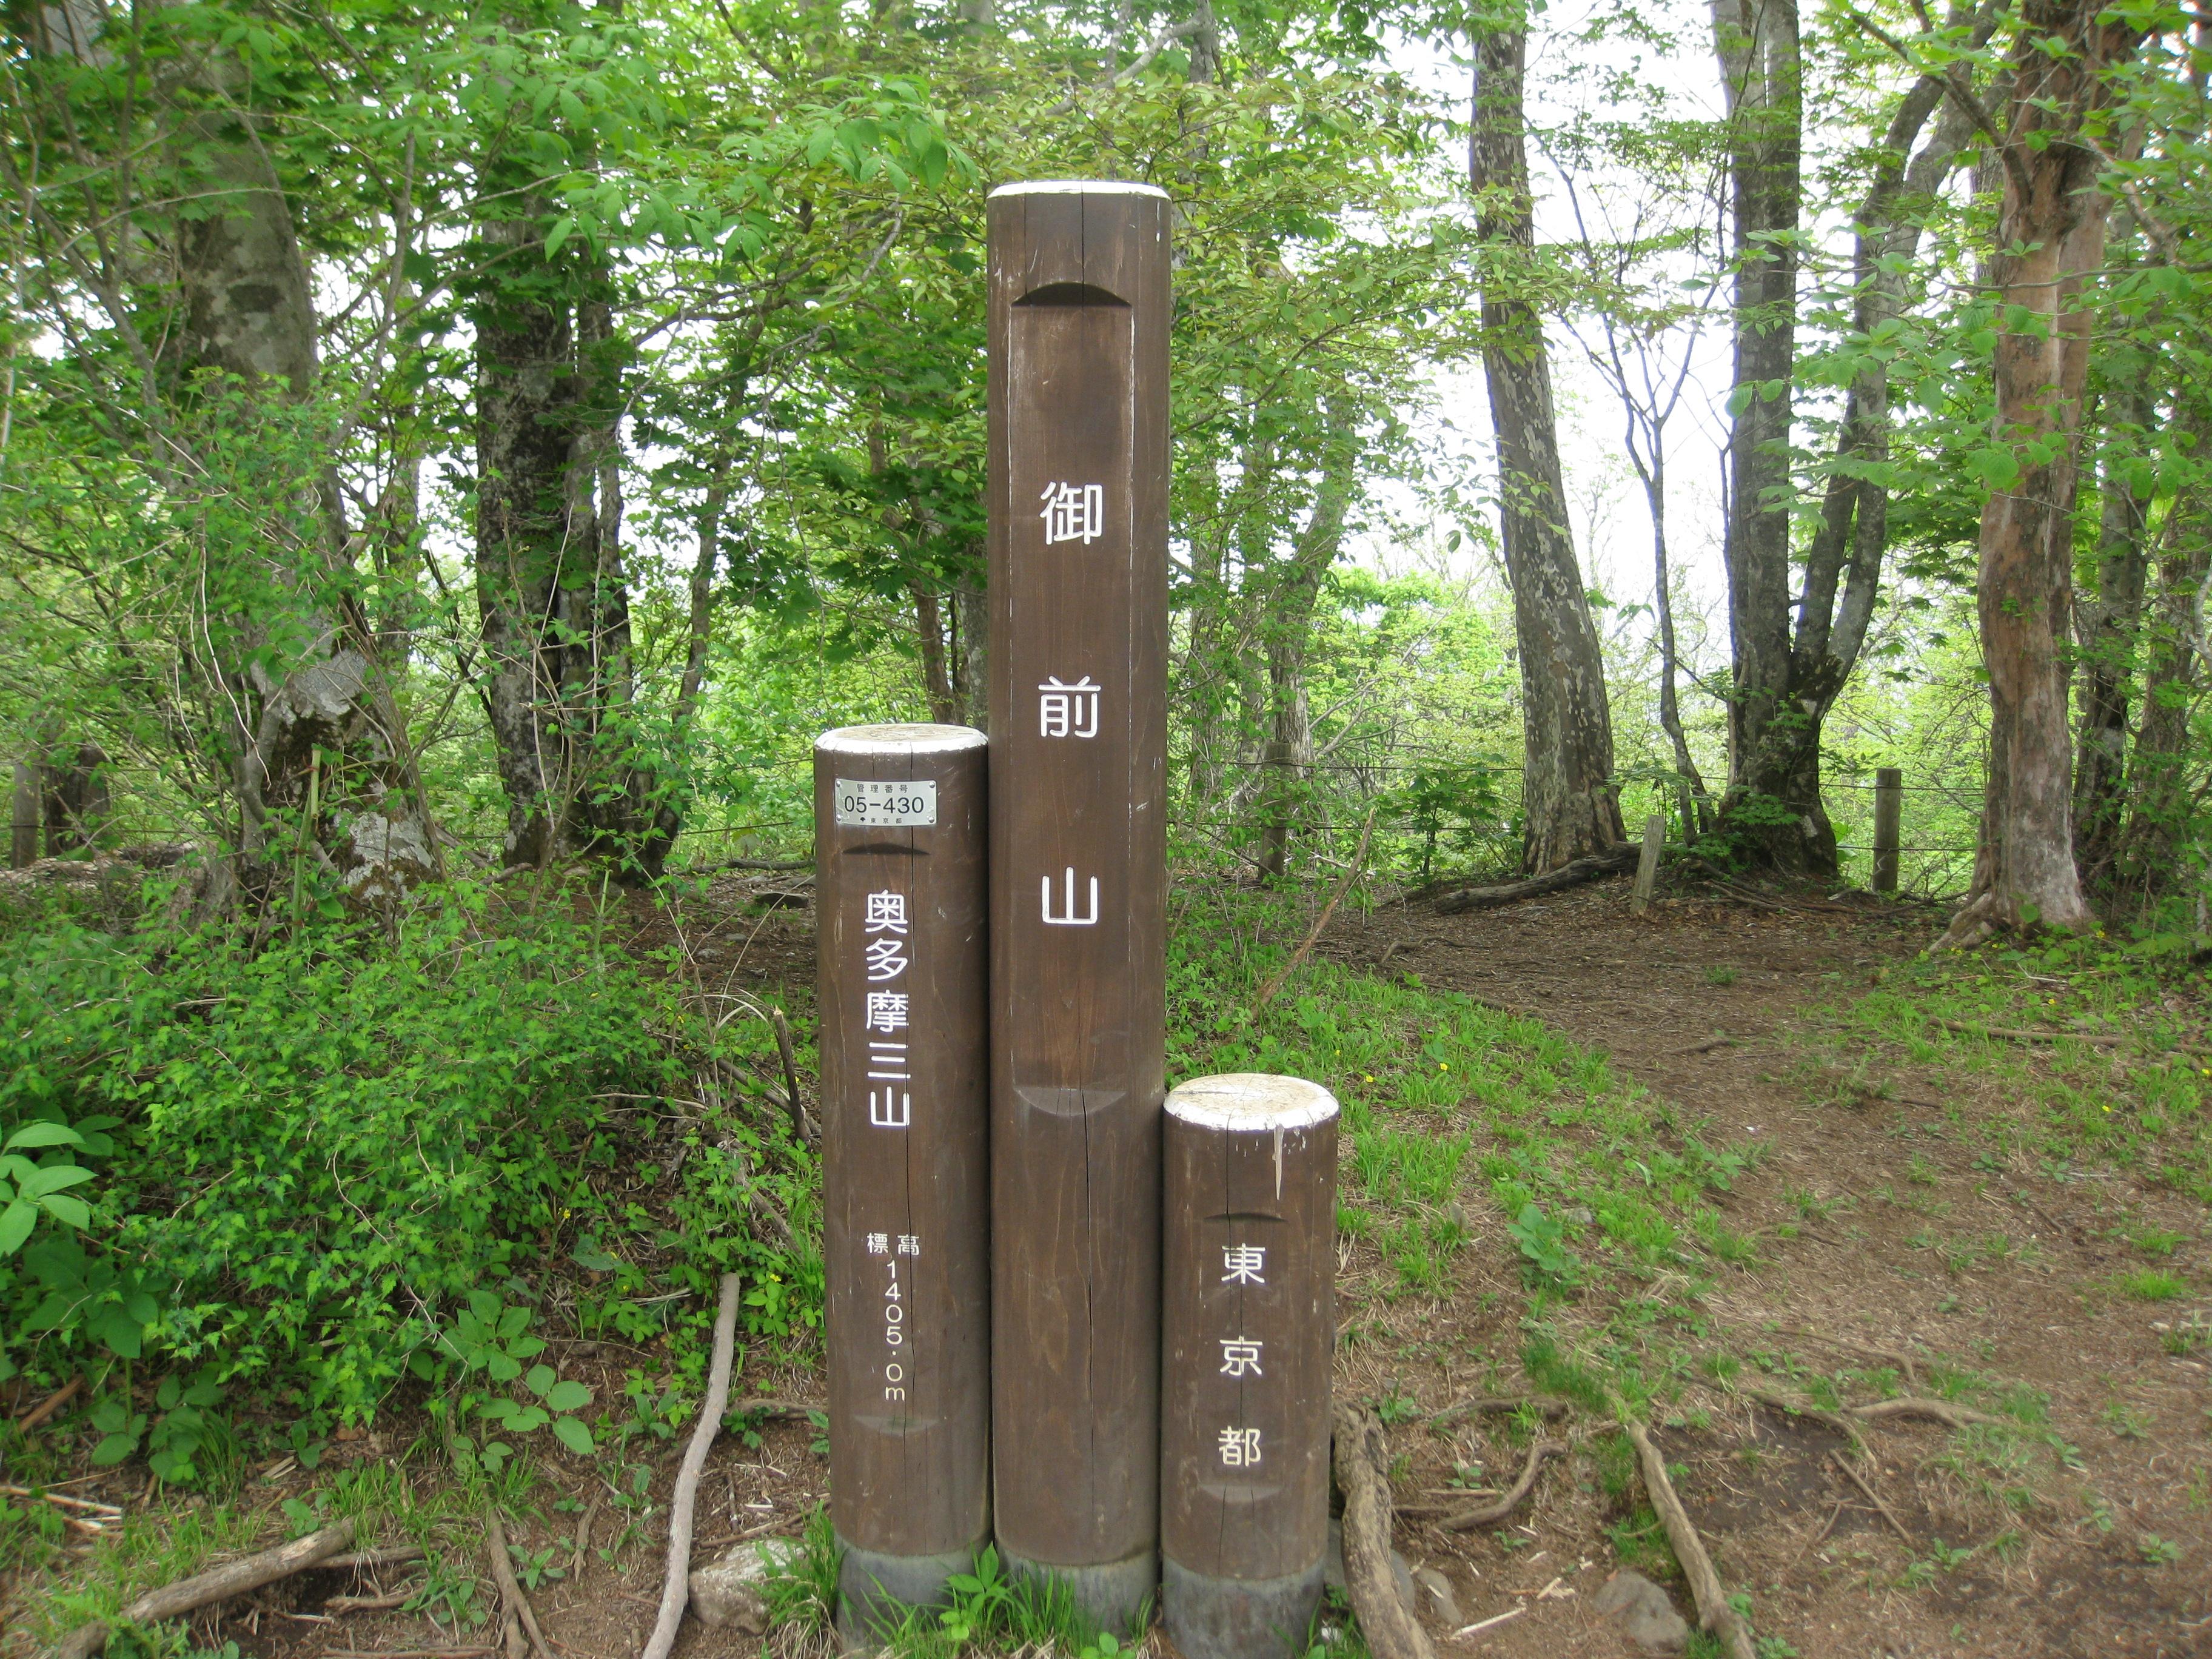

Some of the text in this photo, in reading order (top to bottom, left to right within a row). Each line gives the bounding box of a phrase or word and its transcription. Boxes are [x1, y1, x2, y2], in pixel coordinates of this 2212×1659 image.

[1038, 481, 1103, 925] 御前山
[844, 796, 924, 814] 05-430
[857, 783, 908, 793] 管理番号
[865, 890, 911, 1127] 奥多摩三山
[866, 1232, 920, 1255] 標高
[1218, 1242, 1265, 1466] 東京都
